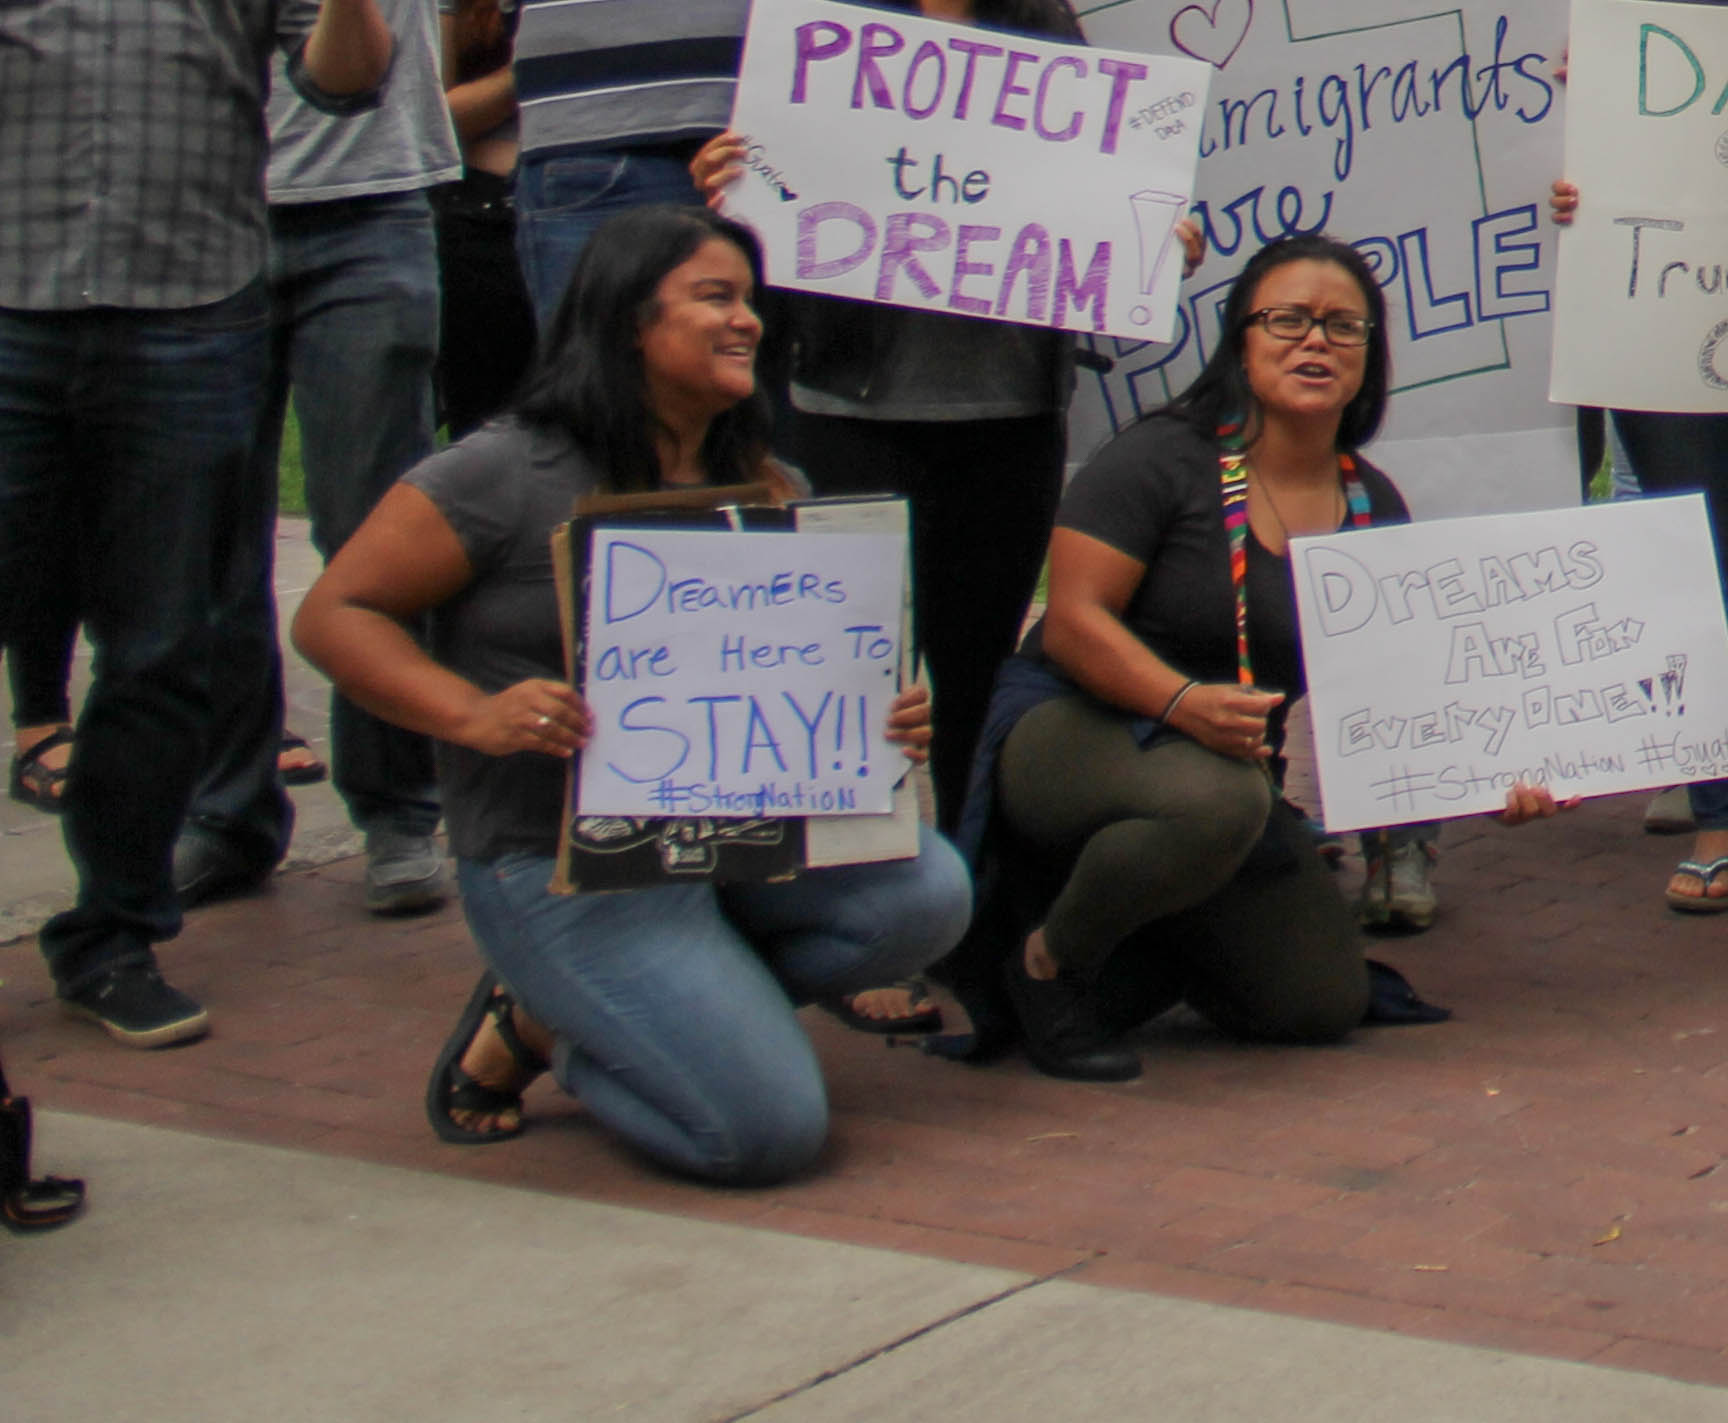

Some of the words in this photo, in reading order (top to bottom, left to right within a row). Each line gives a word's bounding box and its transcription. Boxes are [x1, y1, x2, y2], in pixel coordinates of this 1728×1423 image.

[790, 20, 1149, 155] PROTECT
[886, 146, 990, 204] the
[596, 646, 677, 681] are
[721, 634, 825, 673] Here
[845, 625, 893, 659] To
[607, 690, 869, 783] STAY!!
